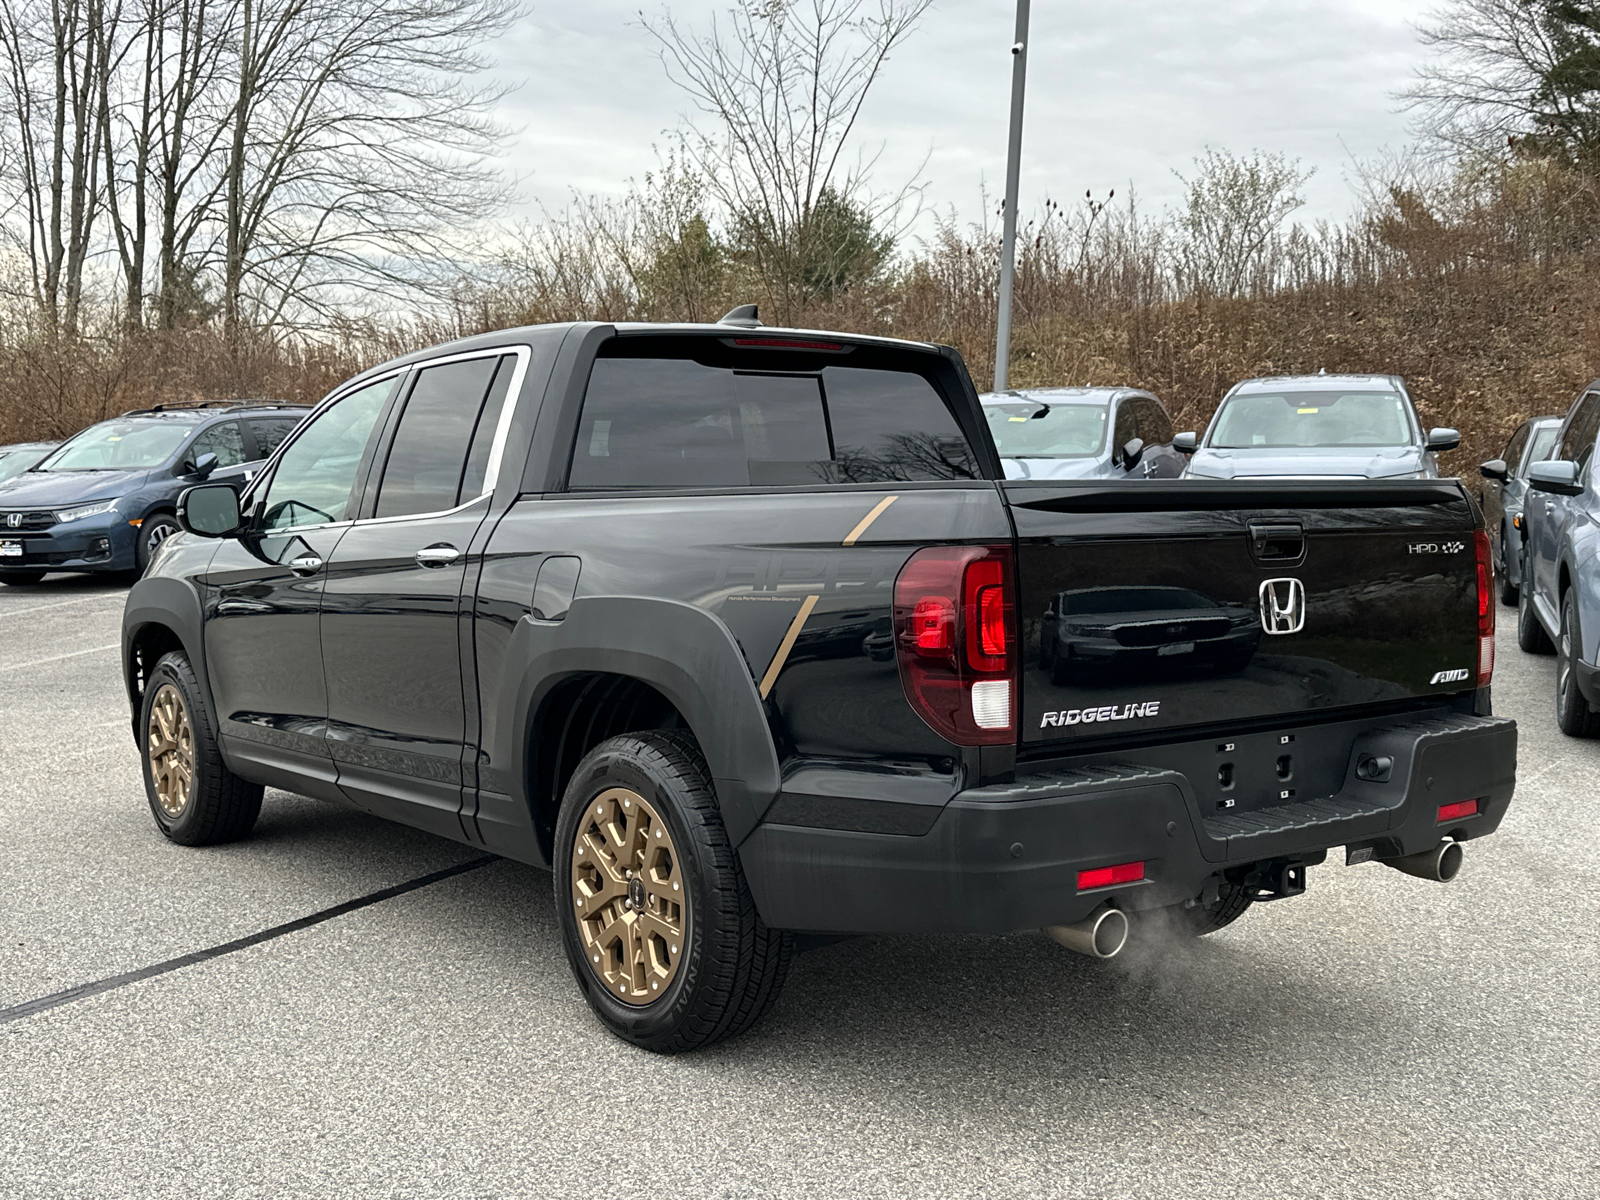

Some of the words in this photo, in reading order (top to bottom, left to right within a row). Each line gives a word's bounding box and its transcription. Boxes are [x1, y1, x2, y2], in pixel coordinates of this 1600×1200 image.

[1409, 543, 1438, 554] HPD
[713, 551, 885, 592] HPD
[1430, 668, 1470, 684] AWD
[1040, 701, 1161, 728] RIDGELINE
